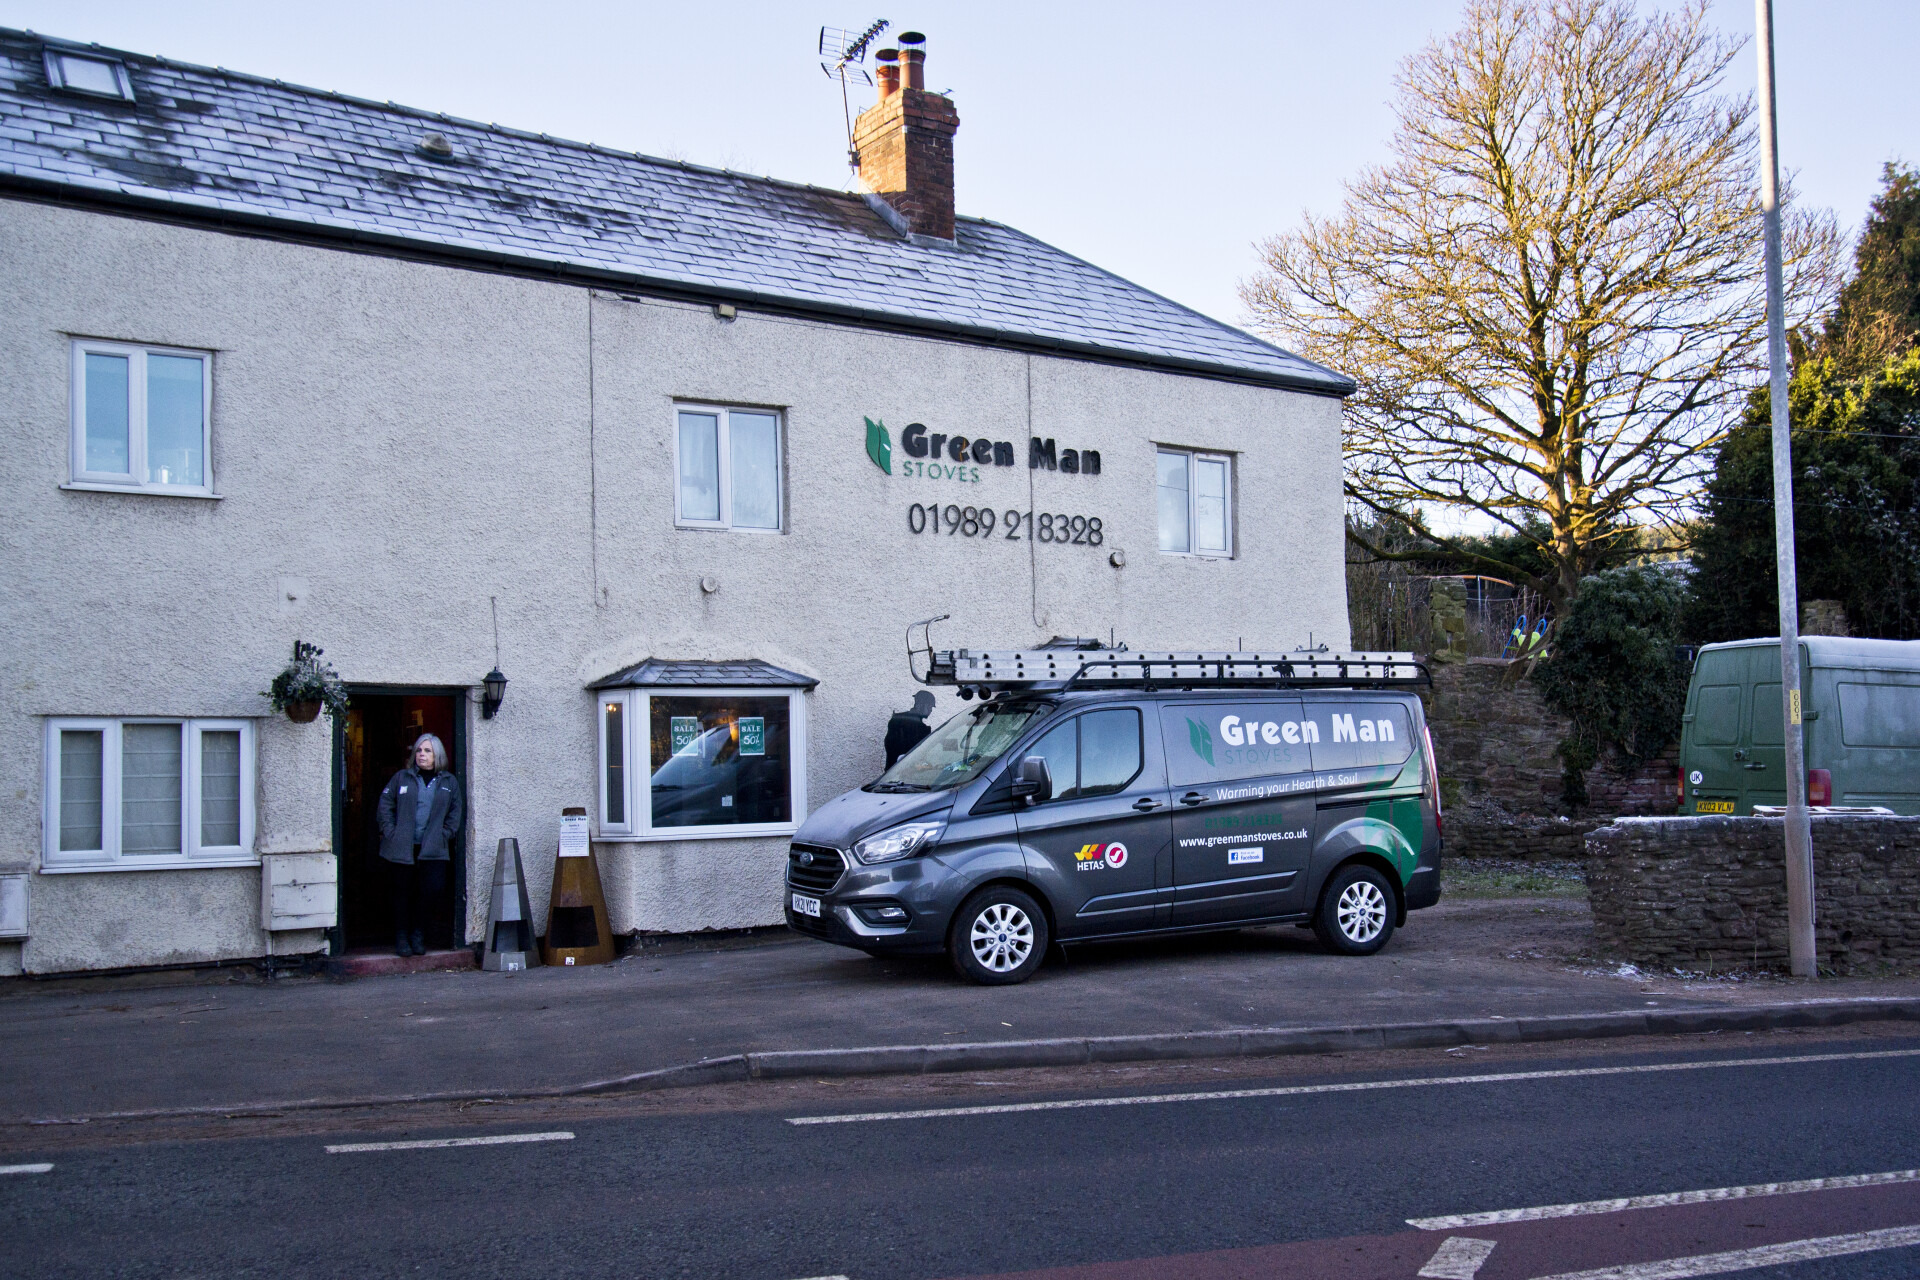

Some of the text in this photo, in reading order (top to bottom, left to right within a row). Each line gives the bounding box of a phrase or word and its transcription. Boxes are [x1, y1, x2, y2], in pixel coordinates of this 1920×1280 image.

[902, 423, 1101, 474] Green Man
[903, 461, 980, 482] STOVES
[909, 503, 1104, 546] 01989 218328
[673, 725, 695, 733] SALE
[741, 724, 762, 733] SALE
[1220, 713, 1395, 747] Green Man
[1225, 748, 1292, 764] STOVES
[1691, 773, 1701, 781] UK
[1216, 772, 1358, 800] Warming your Hearth & Soul
[1698, 802, 1732, 812] KX03 VLN
[1179, 829, 1308, 848] www.greenmanstoves.co.uk
[1076, 860, 1105, 871] HETAS
